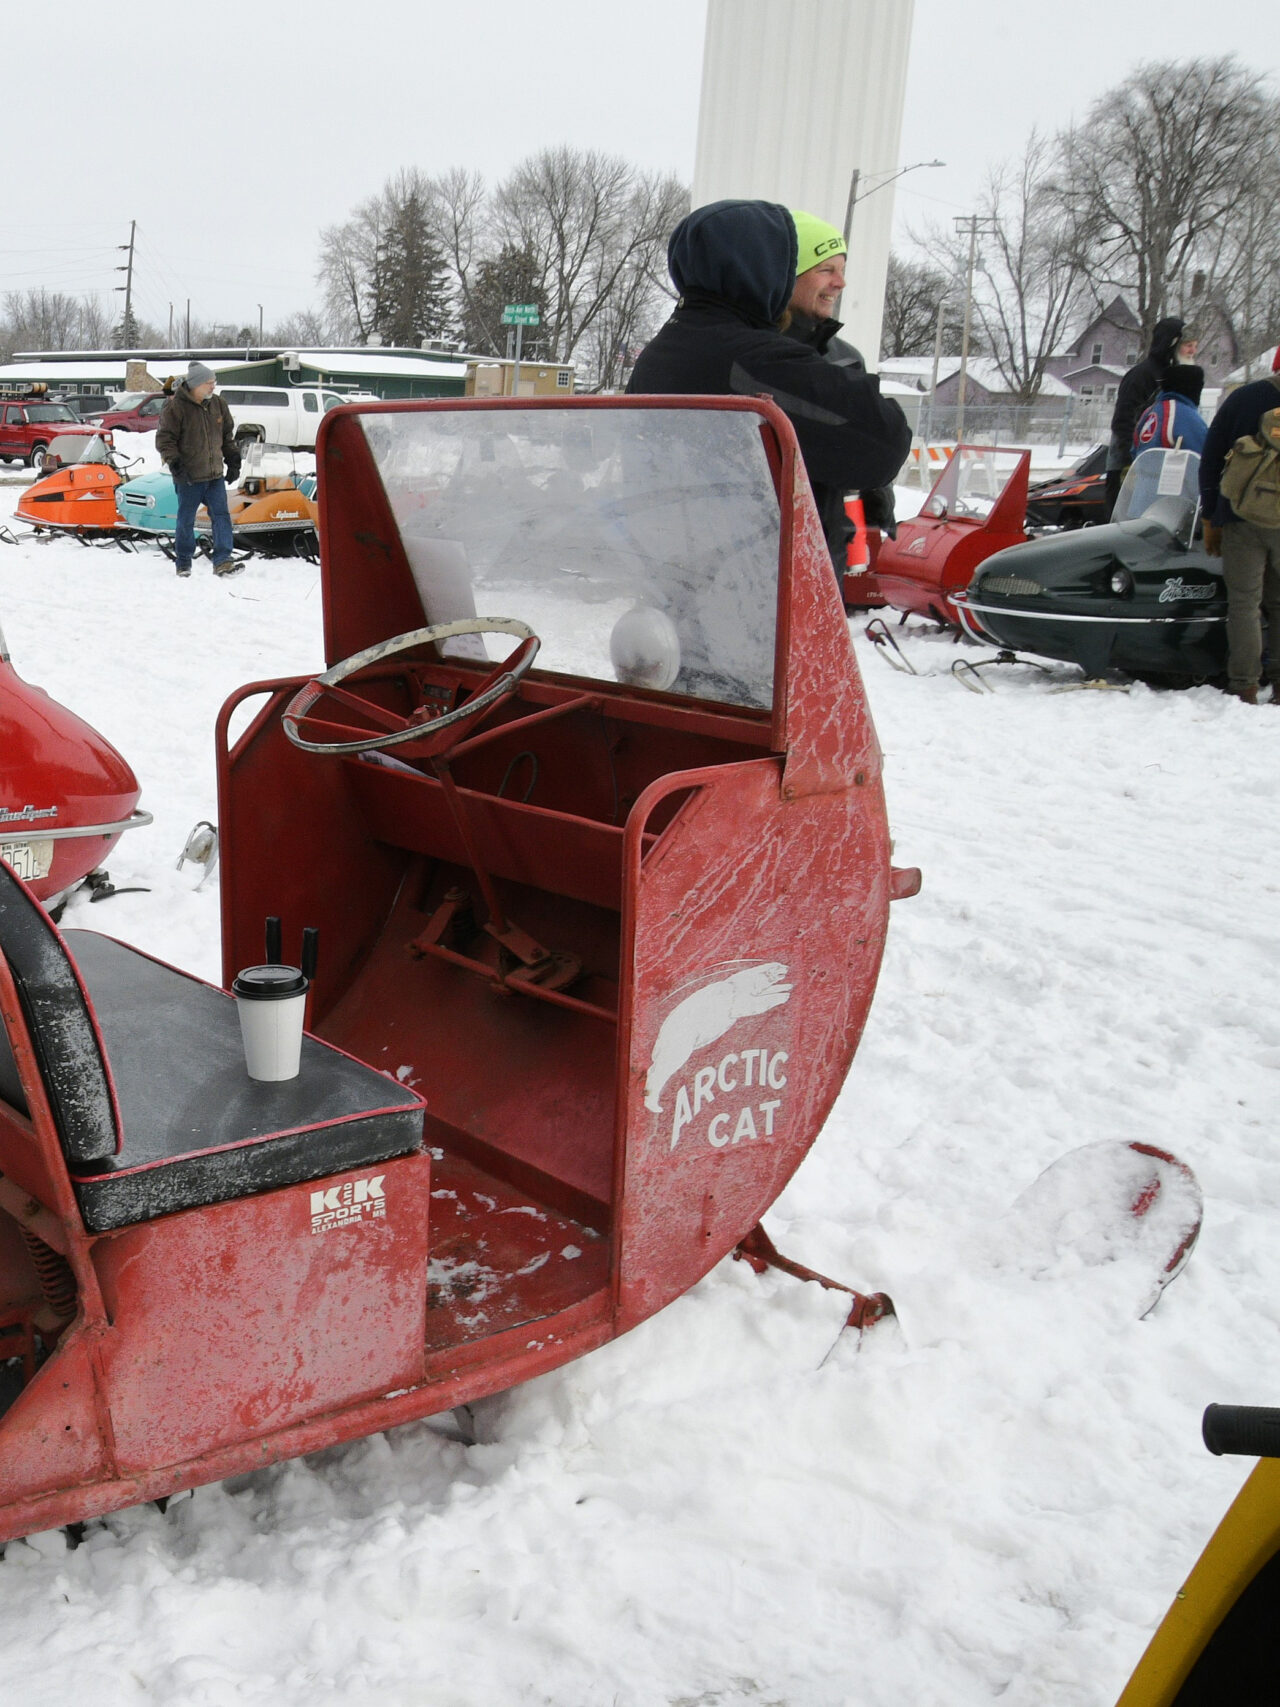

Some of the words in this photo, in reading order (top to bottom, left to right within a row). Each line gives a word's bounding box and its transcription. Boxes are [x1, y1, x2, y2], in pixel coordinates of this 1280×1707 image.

[670, 1049, 789, 1152] ARCTIC
[708, 1100, 781, 1148] CAT
[310, 1186, 342, 1215] K
[354, 1175, 386, 1203] K
[311, 1198, 385, 1227] SPORTS
[311, 1215, 362, 1234] ALEXANDRIA
